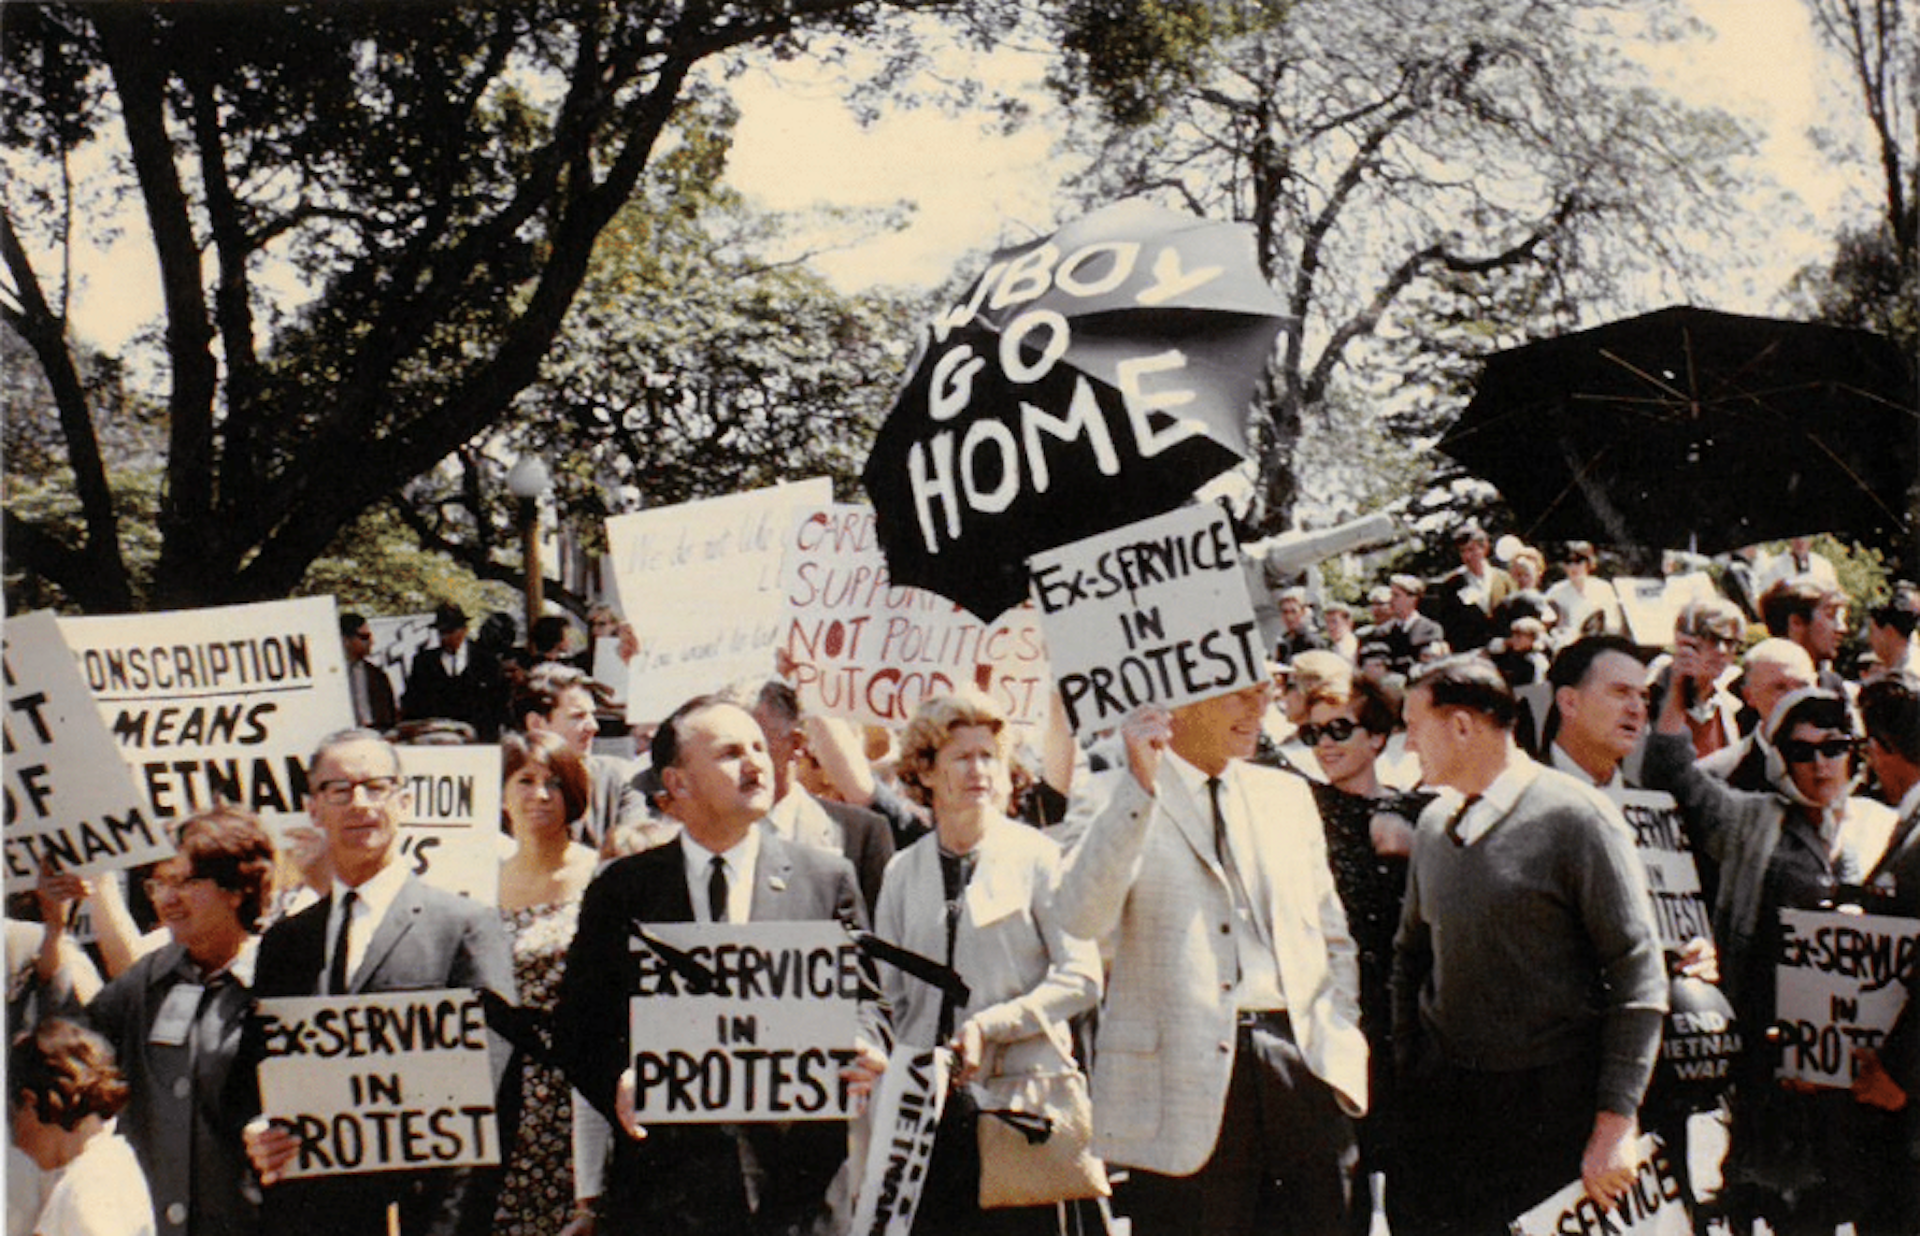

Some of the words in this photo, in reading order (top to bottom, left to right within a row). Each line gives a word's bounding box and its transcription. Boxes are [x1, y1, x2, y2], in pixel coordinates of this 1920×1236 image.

[928, 308, 1072, 421] GO
[908, 348, 1210, 556] HOME
[787, 614, 871, 661] NOT
[880, 616, 1041, 667] POLITICS
[1119, 606, 1166, 650] IN
[796, 663, 865, 711] PUT
[1057, 620, 1259, 736] PROTEST
[112, 702, 278, 748] MEANS
[718, 1014, 756, 1046] IN
[1671, 1010, 1728, 1034] END
[1831, 994, 1858, 1023] IN
[350, 1073, 402, 1107] IN
[634, 1047, 860, 1113] PROTEST
